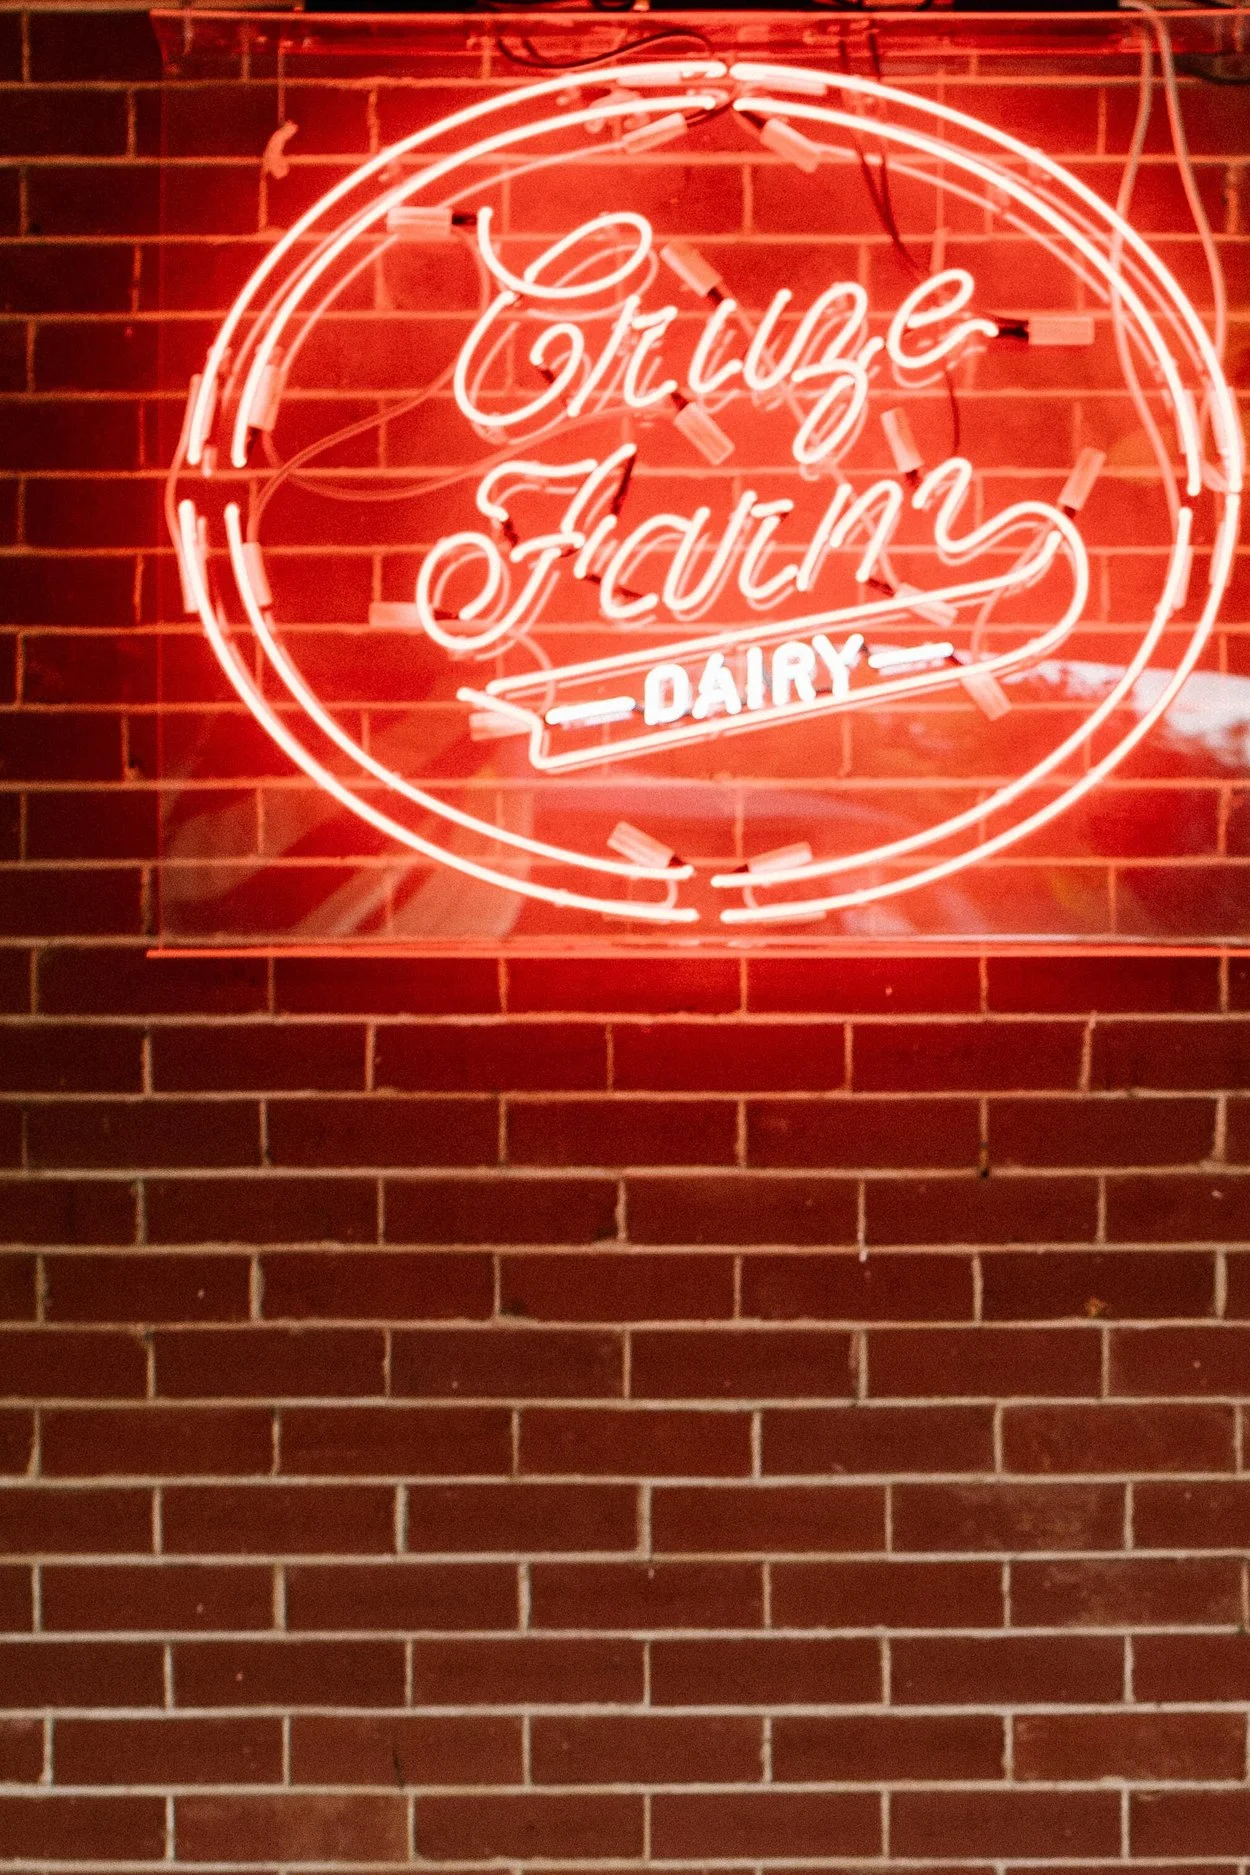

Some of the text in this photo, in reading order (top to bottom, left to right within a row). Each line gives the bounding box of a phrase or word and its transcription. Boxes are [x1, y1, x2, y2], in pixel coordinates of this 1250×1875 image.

[453, 206, 1000, 464] Cruze
[417, 443, 1020, 651] Farm
[643, 632, 865, 726] DAIRY
